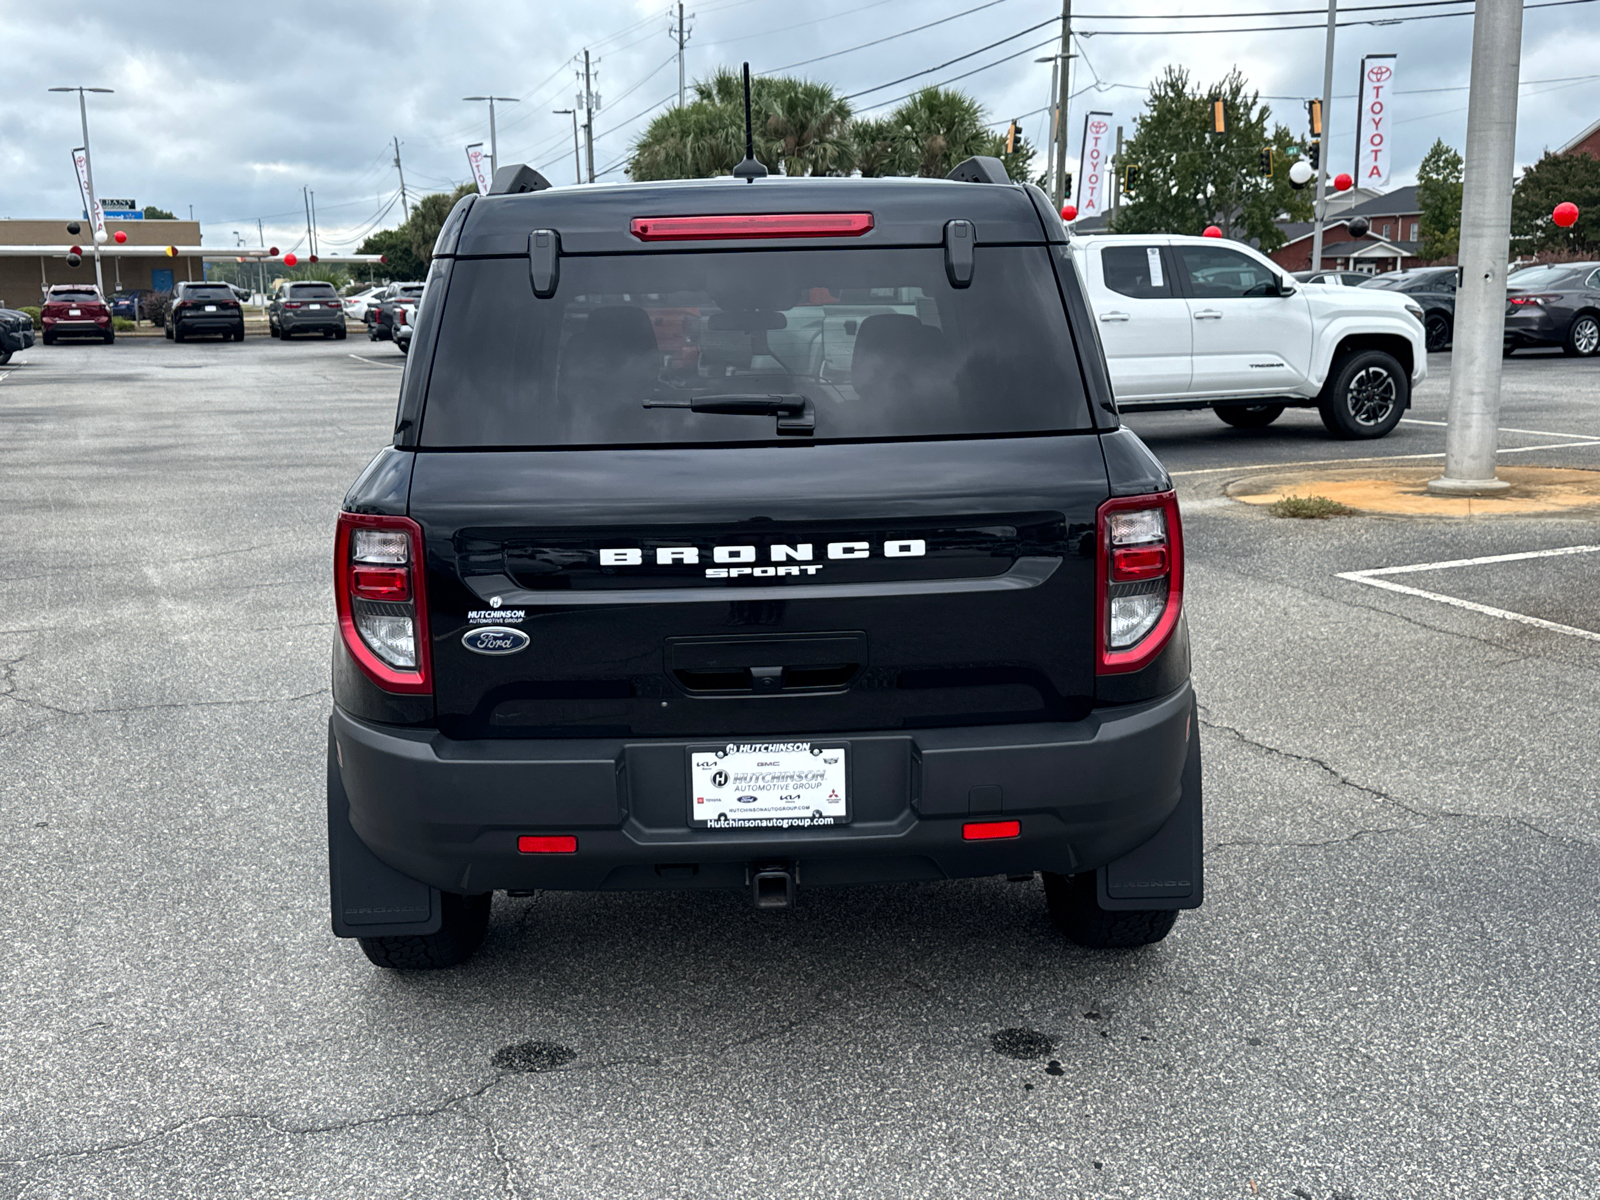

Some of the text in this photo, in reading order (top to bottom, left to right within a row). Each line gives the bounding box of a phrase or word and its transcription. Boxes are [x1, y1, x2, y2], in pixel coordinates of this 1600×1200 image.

[1368, 85, 1384, 178] TOYOTA
[475, 164, 488, 192] TOY
[1085, 136, 1101, 209] TOYOTA
[81, 169, 103, 231] TOOTA
[599, 539, 926, 566] BRONCO
[705, 564, 823, 578] SPORT
[468, 610, 525, 619] HUTCHINSON
[477, 632, 513, 648] Ford
[739, 742, 811, 753] HUTCHINSON
[732, 770, 826, 785] HUTCHINSON
[734, 782, 822, 792] AUTOMOTIVE GROUP
[729, 805, 811, 813] HUTCHINSONAUTOGROUP.COM
[707, 817, 834, 828] Hutchinsonautogroup.com
